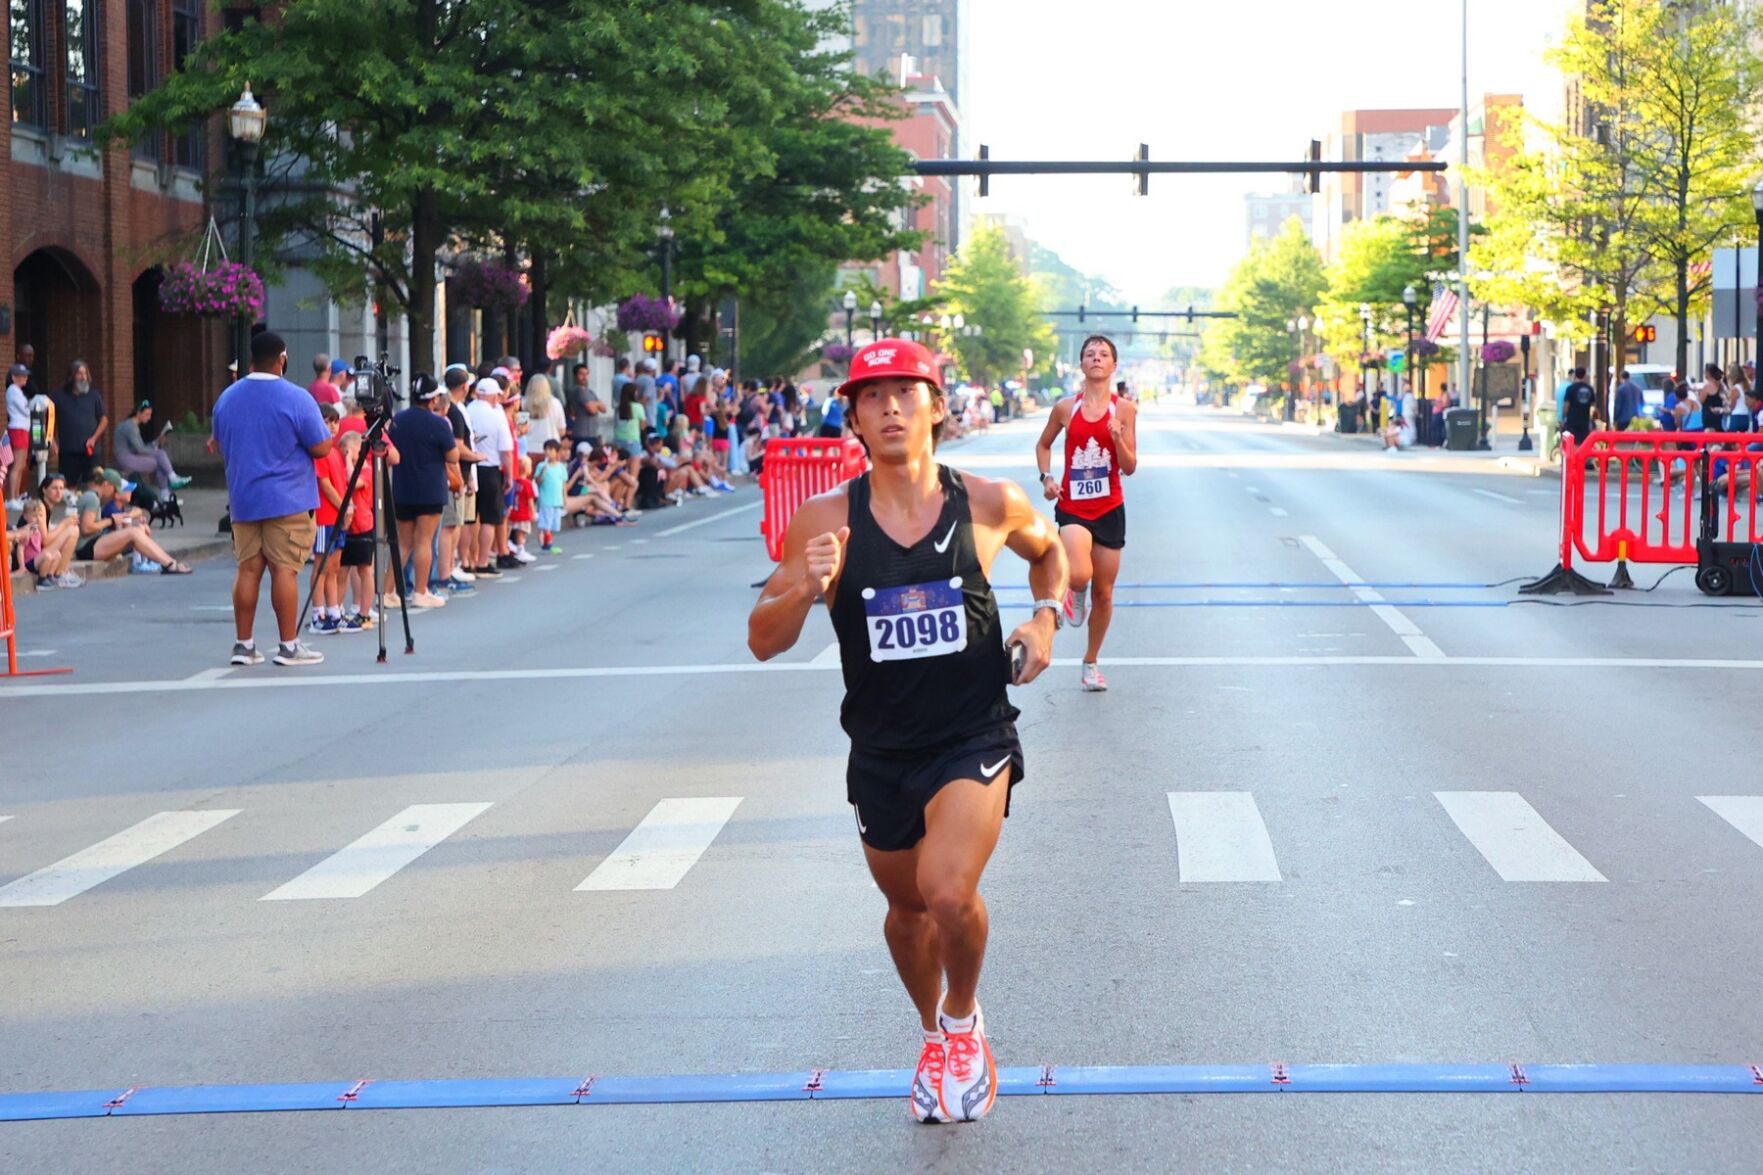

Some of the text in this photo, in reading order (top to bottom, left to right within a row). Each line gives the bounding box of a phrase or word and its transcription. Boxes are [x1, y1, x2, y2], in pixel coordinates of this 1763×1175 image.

[877, 348, 897, 358] ONE
[1077, 480, 1102, 495] 260
[875, 610, 959, 649] 2098
